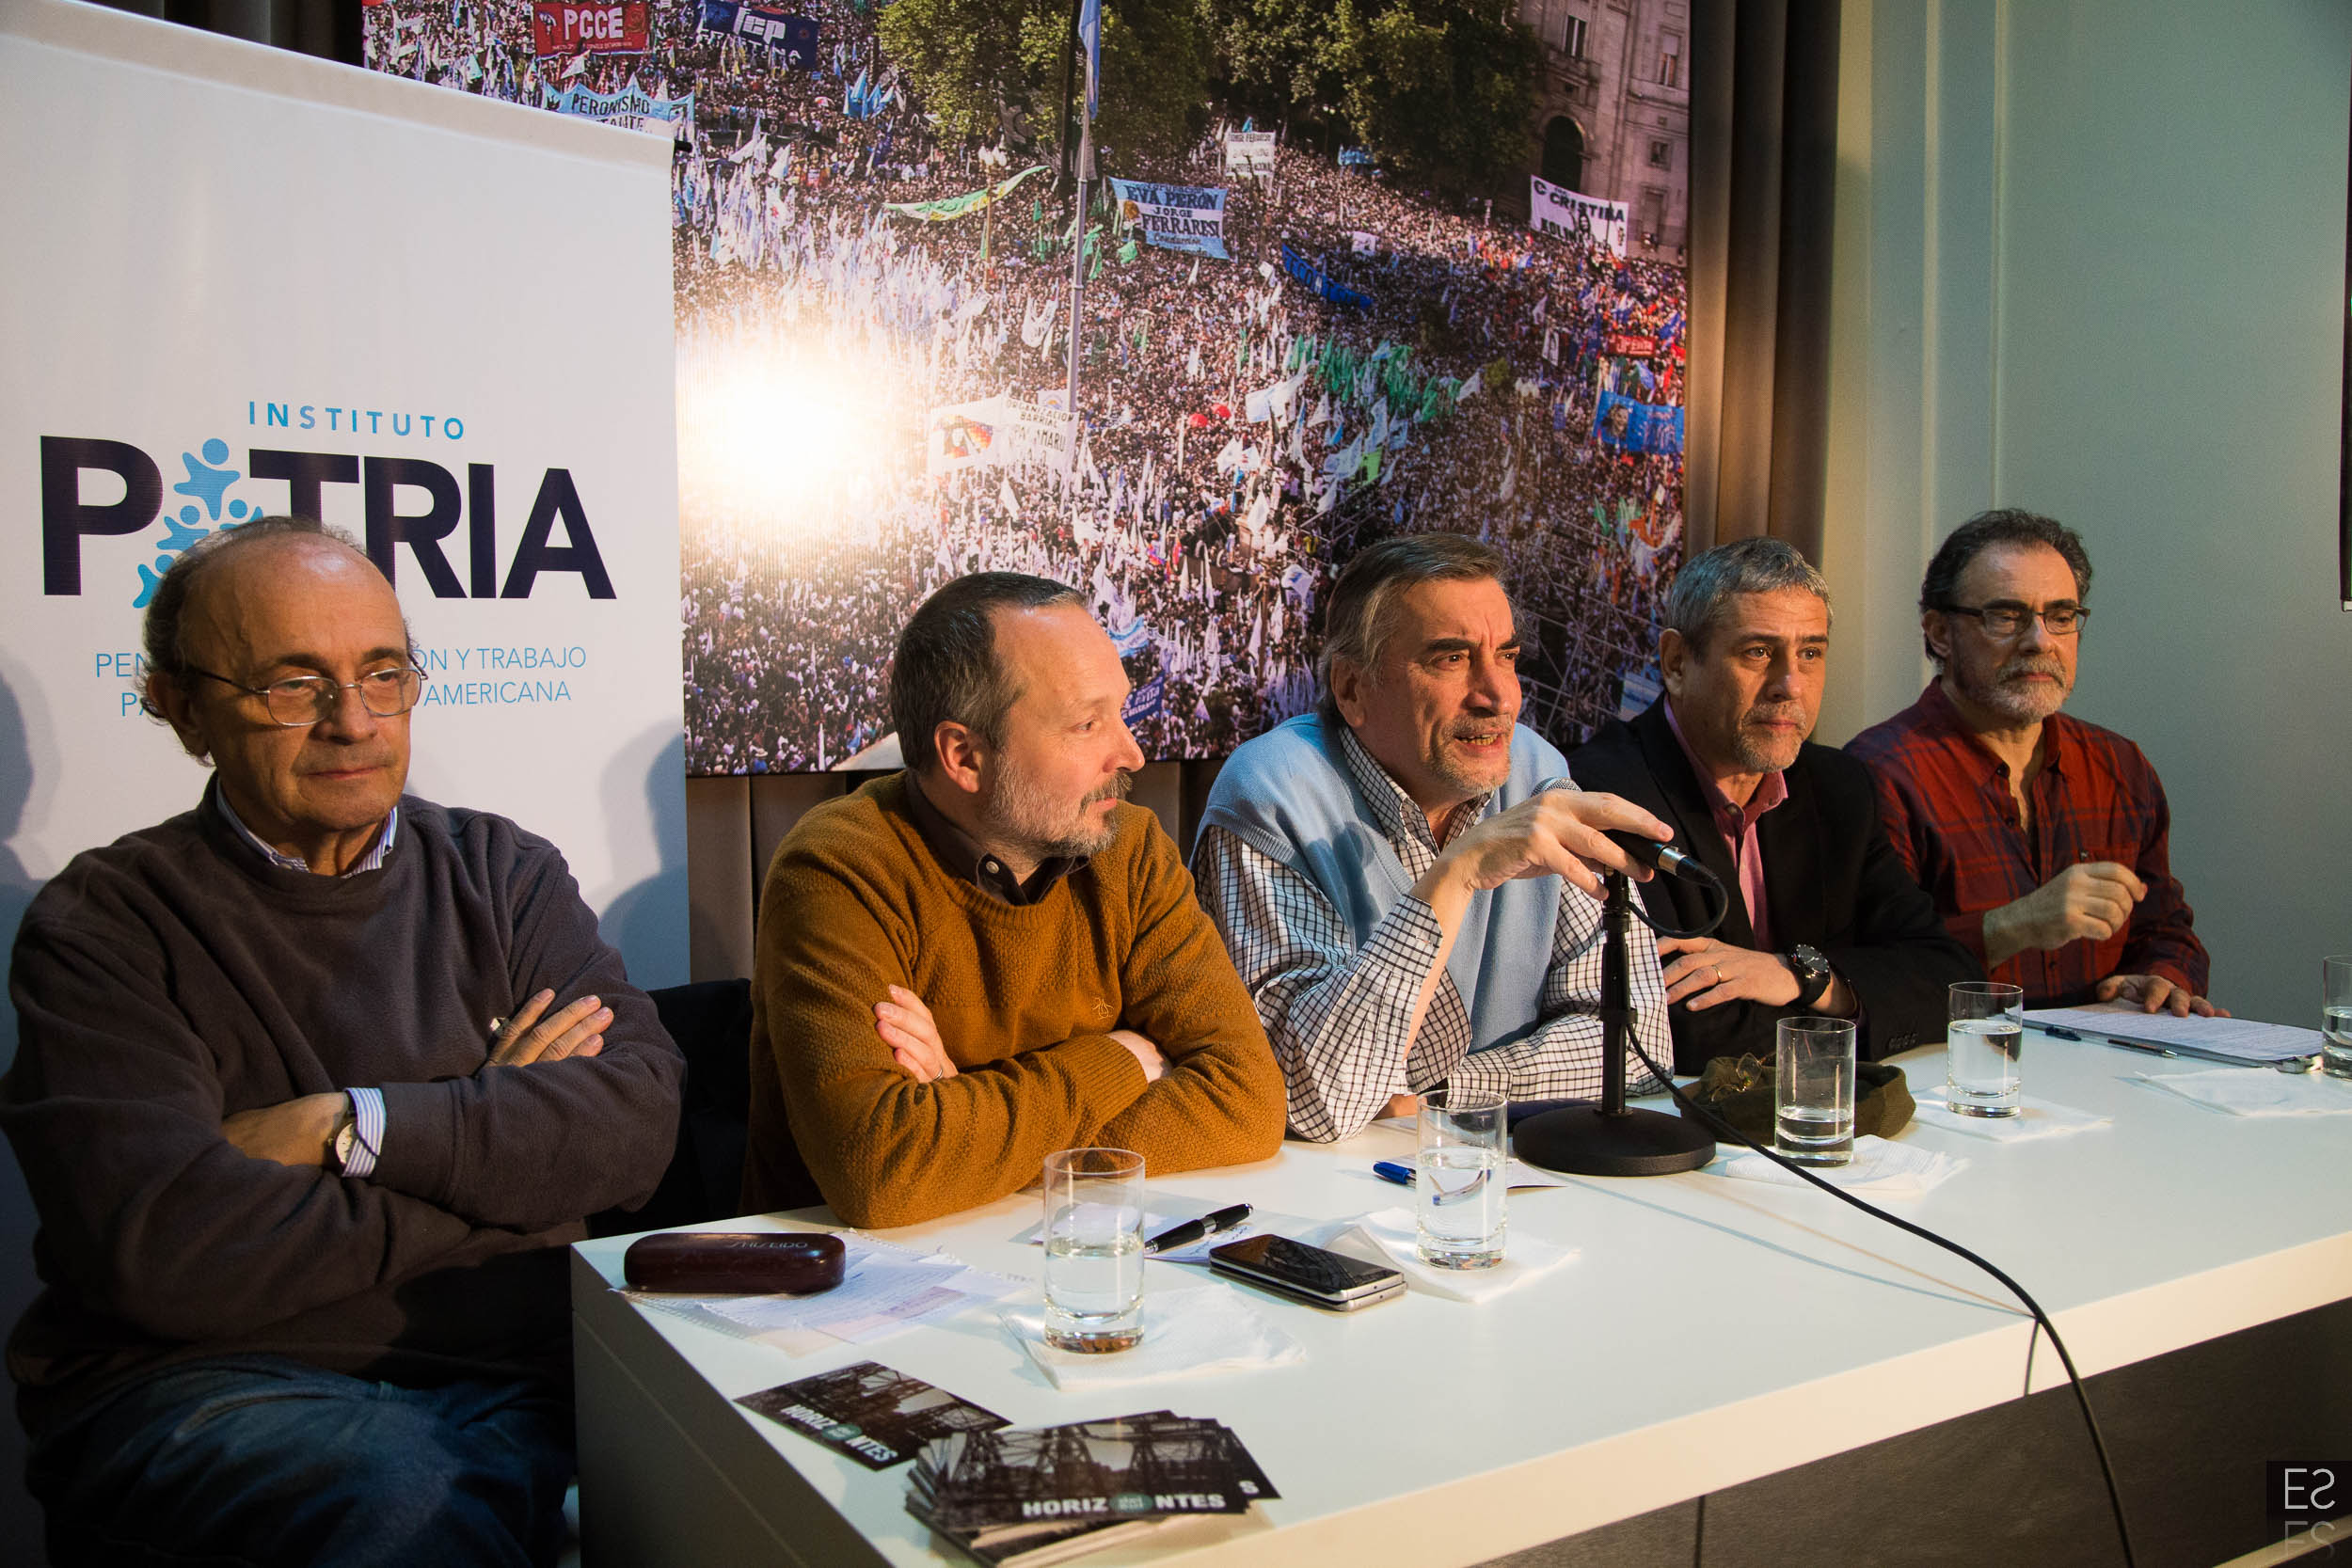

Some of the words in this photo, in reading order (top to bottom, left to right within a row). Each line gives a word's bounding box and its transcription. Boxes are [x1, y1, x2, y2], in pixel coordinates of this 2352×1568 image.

[571, 93, 650, 116] PERONISMO
[1124, 185, 1161, 206] EVA
[1152, 206, 1193, 218] JORGE
[1141, 214, 1220, 238] FERRARESI
[248, 400, 465, 440] INSTITUTO
[1006, 399, 1074, 422] ORGANIZACION
[40, 435, 617, 600] PTRIA
[455, 649, 470, 670] Y
[476, 646, 587, 670] TRABAJO
[423, 680, 571, 706] AMERICANA
